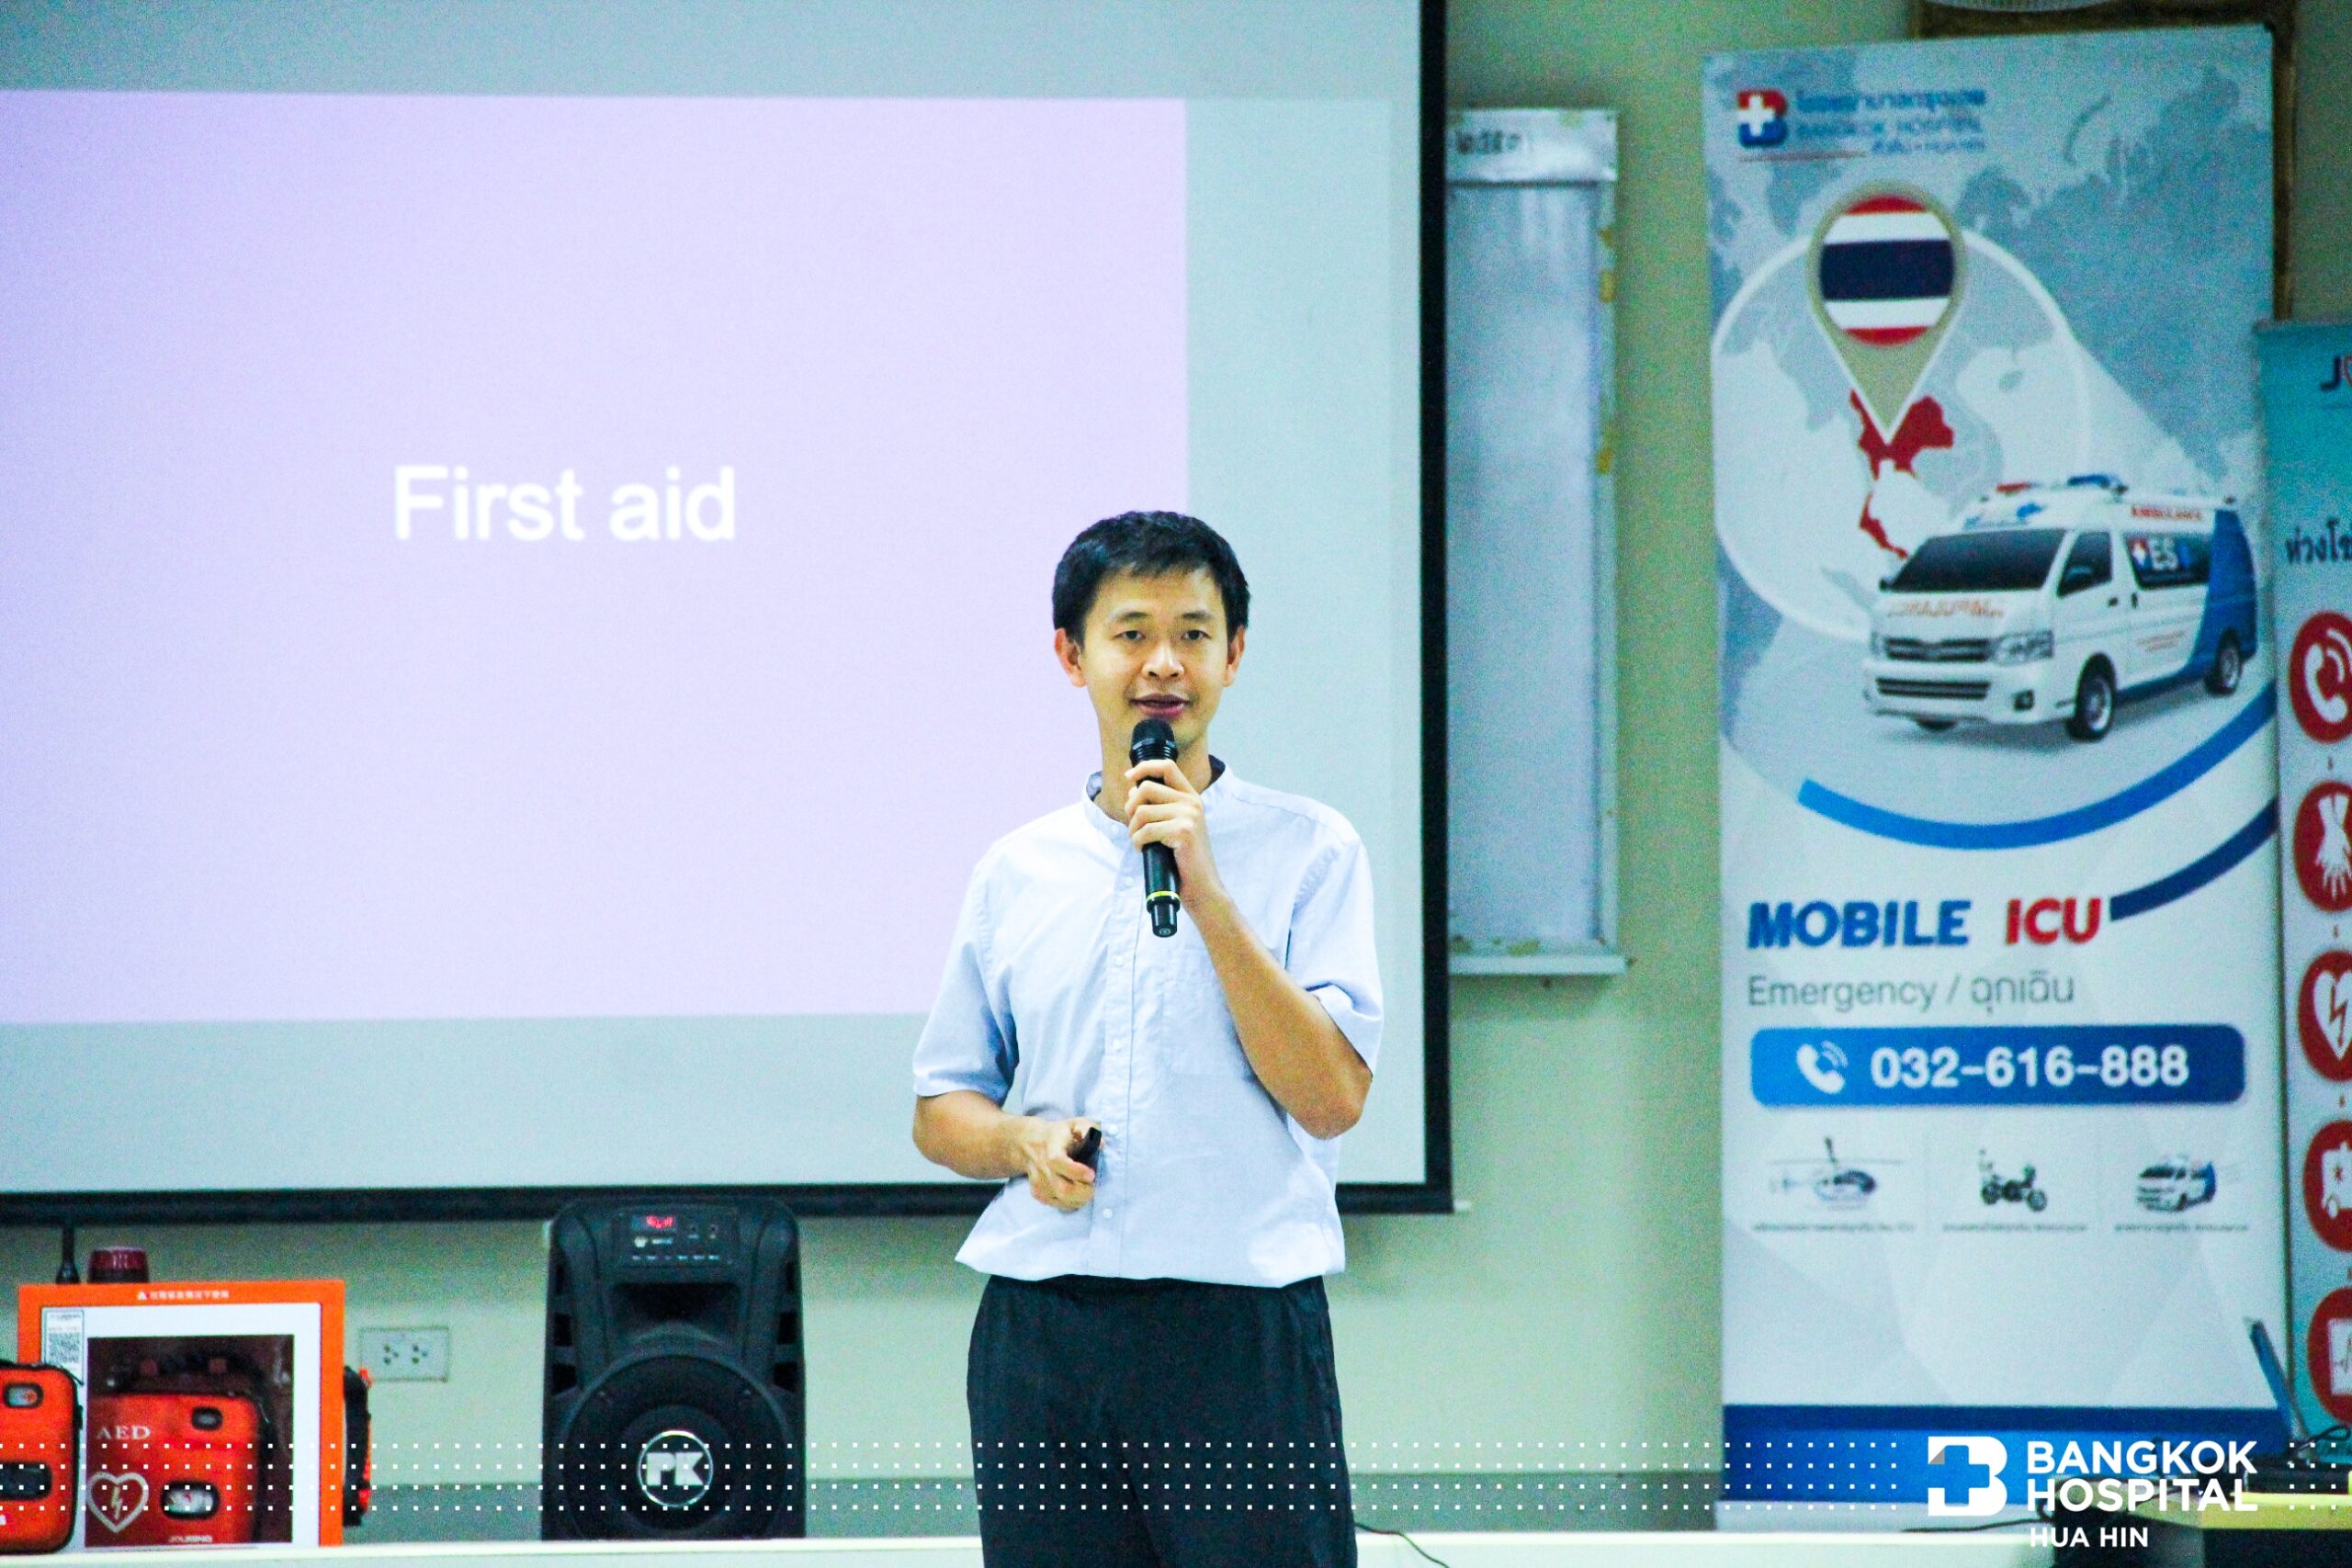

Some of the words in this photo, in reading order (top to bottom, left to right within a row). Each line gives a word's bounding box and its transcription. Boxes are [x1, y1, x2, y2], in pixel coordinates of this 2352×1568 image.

[395, 464, 585, 542] First
[608, 465, 736, 542] aid
[1747, 899, 1972, 950] MOBILE
[2005, 897, 2102, 945] ICU
[1747, 975, 1937, 1012] Emergency
[1870, 1044, 2190, 1089] 032-616-888
[96, 1425, 152, 1441] AED
[646, 1451, 704, 1486] PK
